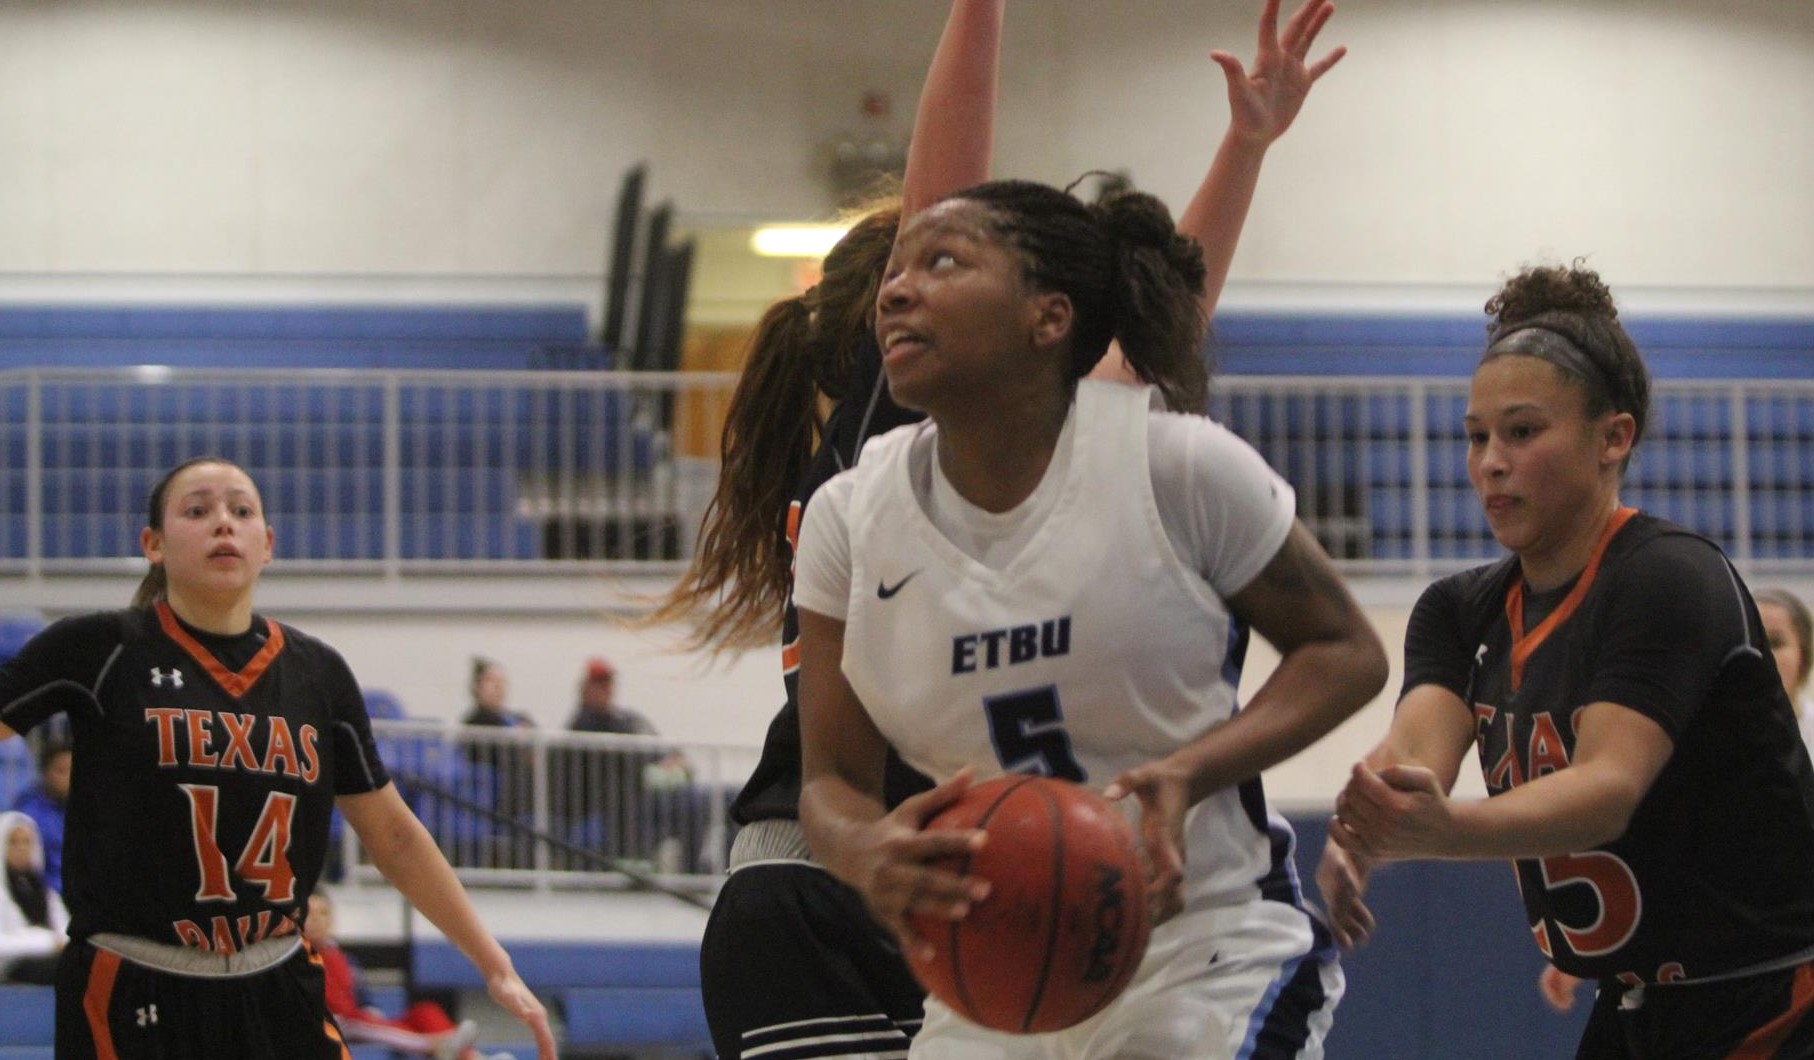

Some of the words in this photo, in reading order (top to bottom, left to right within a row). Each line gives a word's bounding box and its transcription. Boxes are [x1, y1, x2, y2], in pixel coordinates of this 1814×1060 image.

[951, 615, 1071, 675] ETBU
[145, 708, 320, 784] TEXAS
[983, 684, 1088, 783] 5
[178, 784, 298, 901] 14
